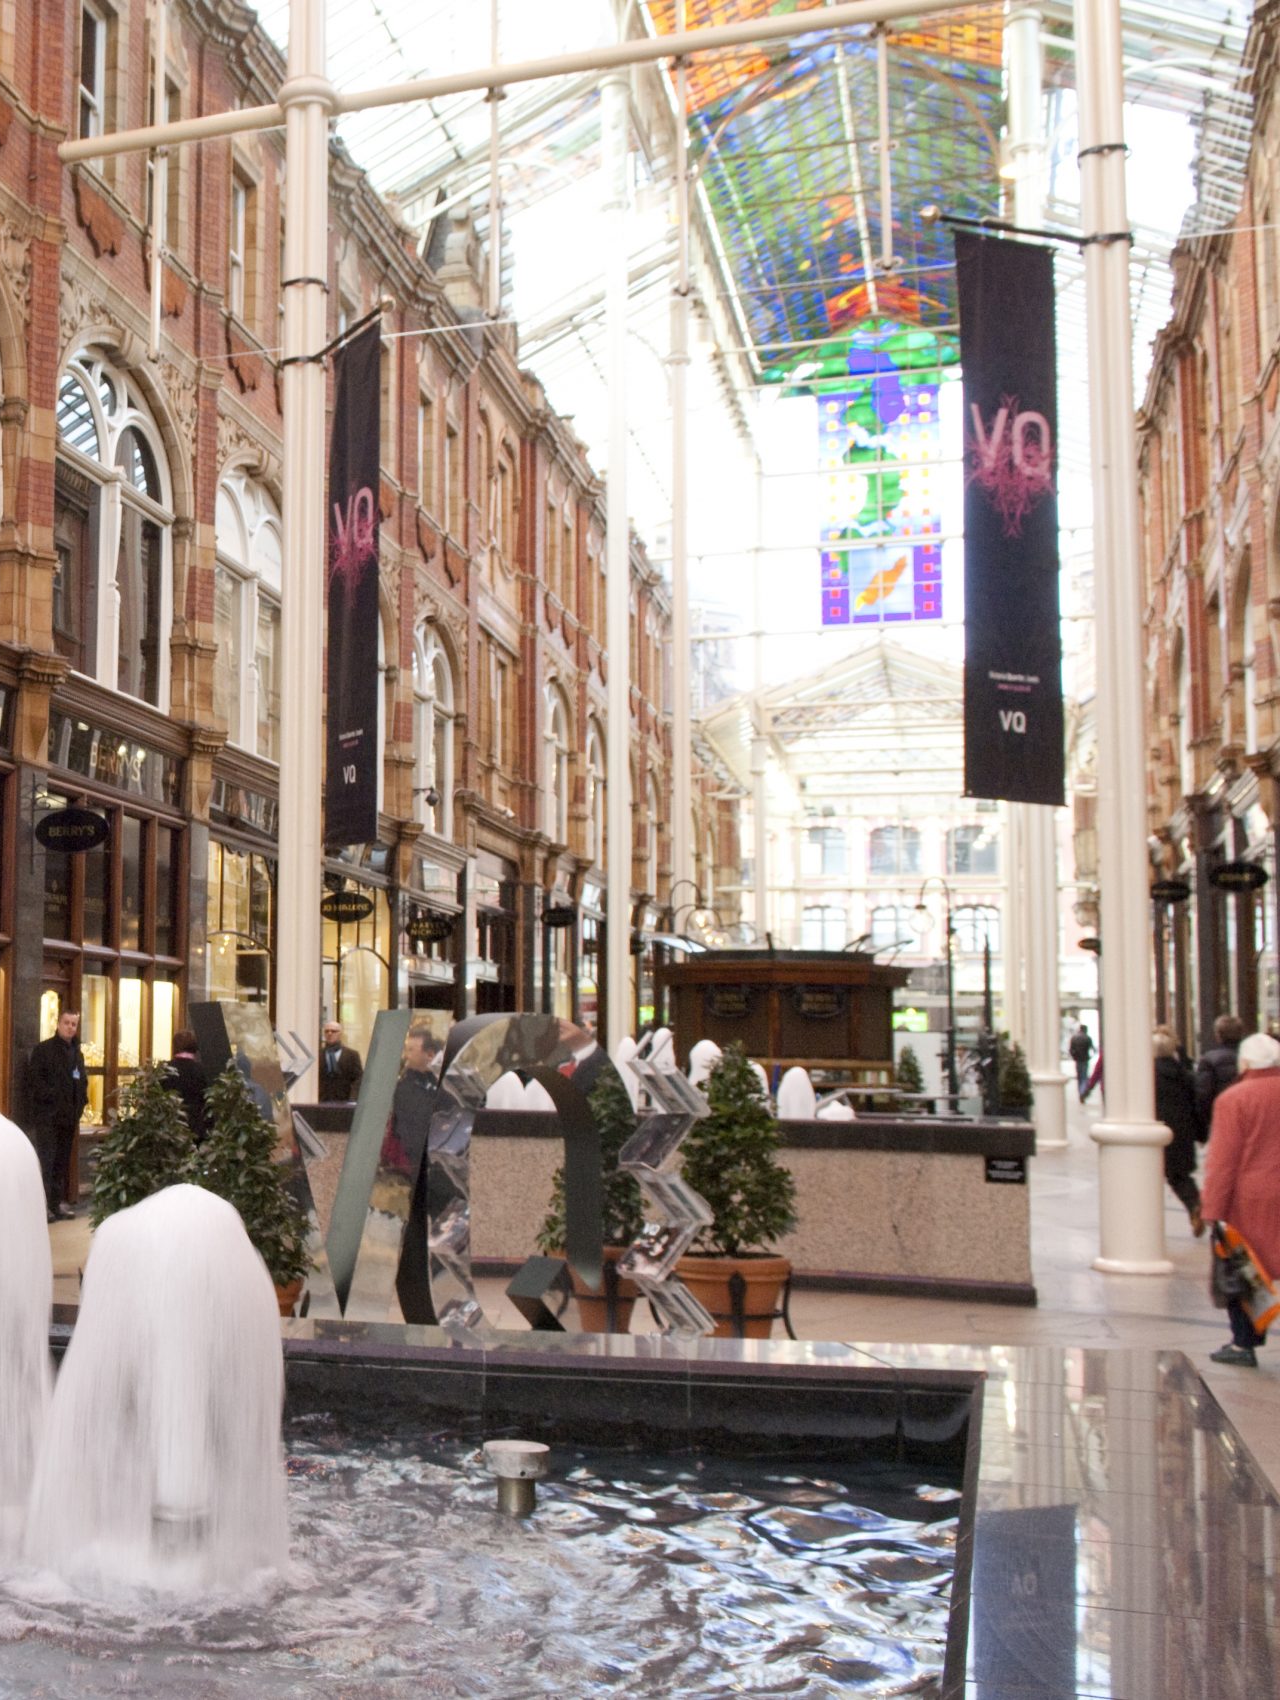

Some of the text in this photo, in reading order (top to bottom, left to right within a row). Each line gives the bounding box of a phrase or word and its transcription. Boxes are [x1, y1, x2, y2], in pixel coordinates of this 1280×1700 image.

[971, 402, 1051, 482] VQ
[334, 486, 374, 555] VQ
[999, 709, 1027, 734] VQ
[343, 764, 356, 784] VQ
